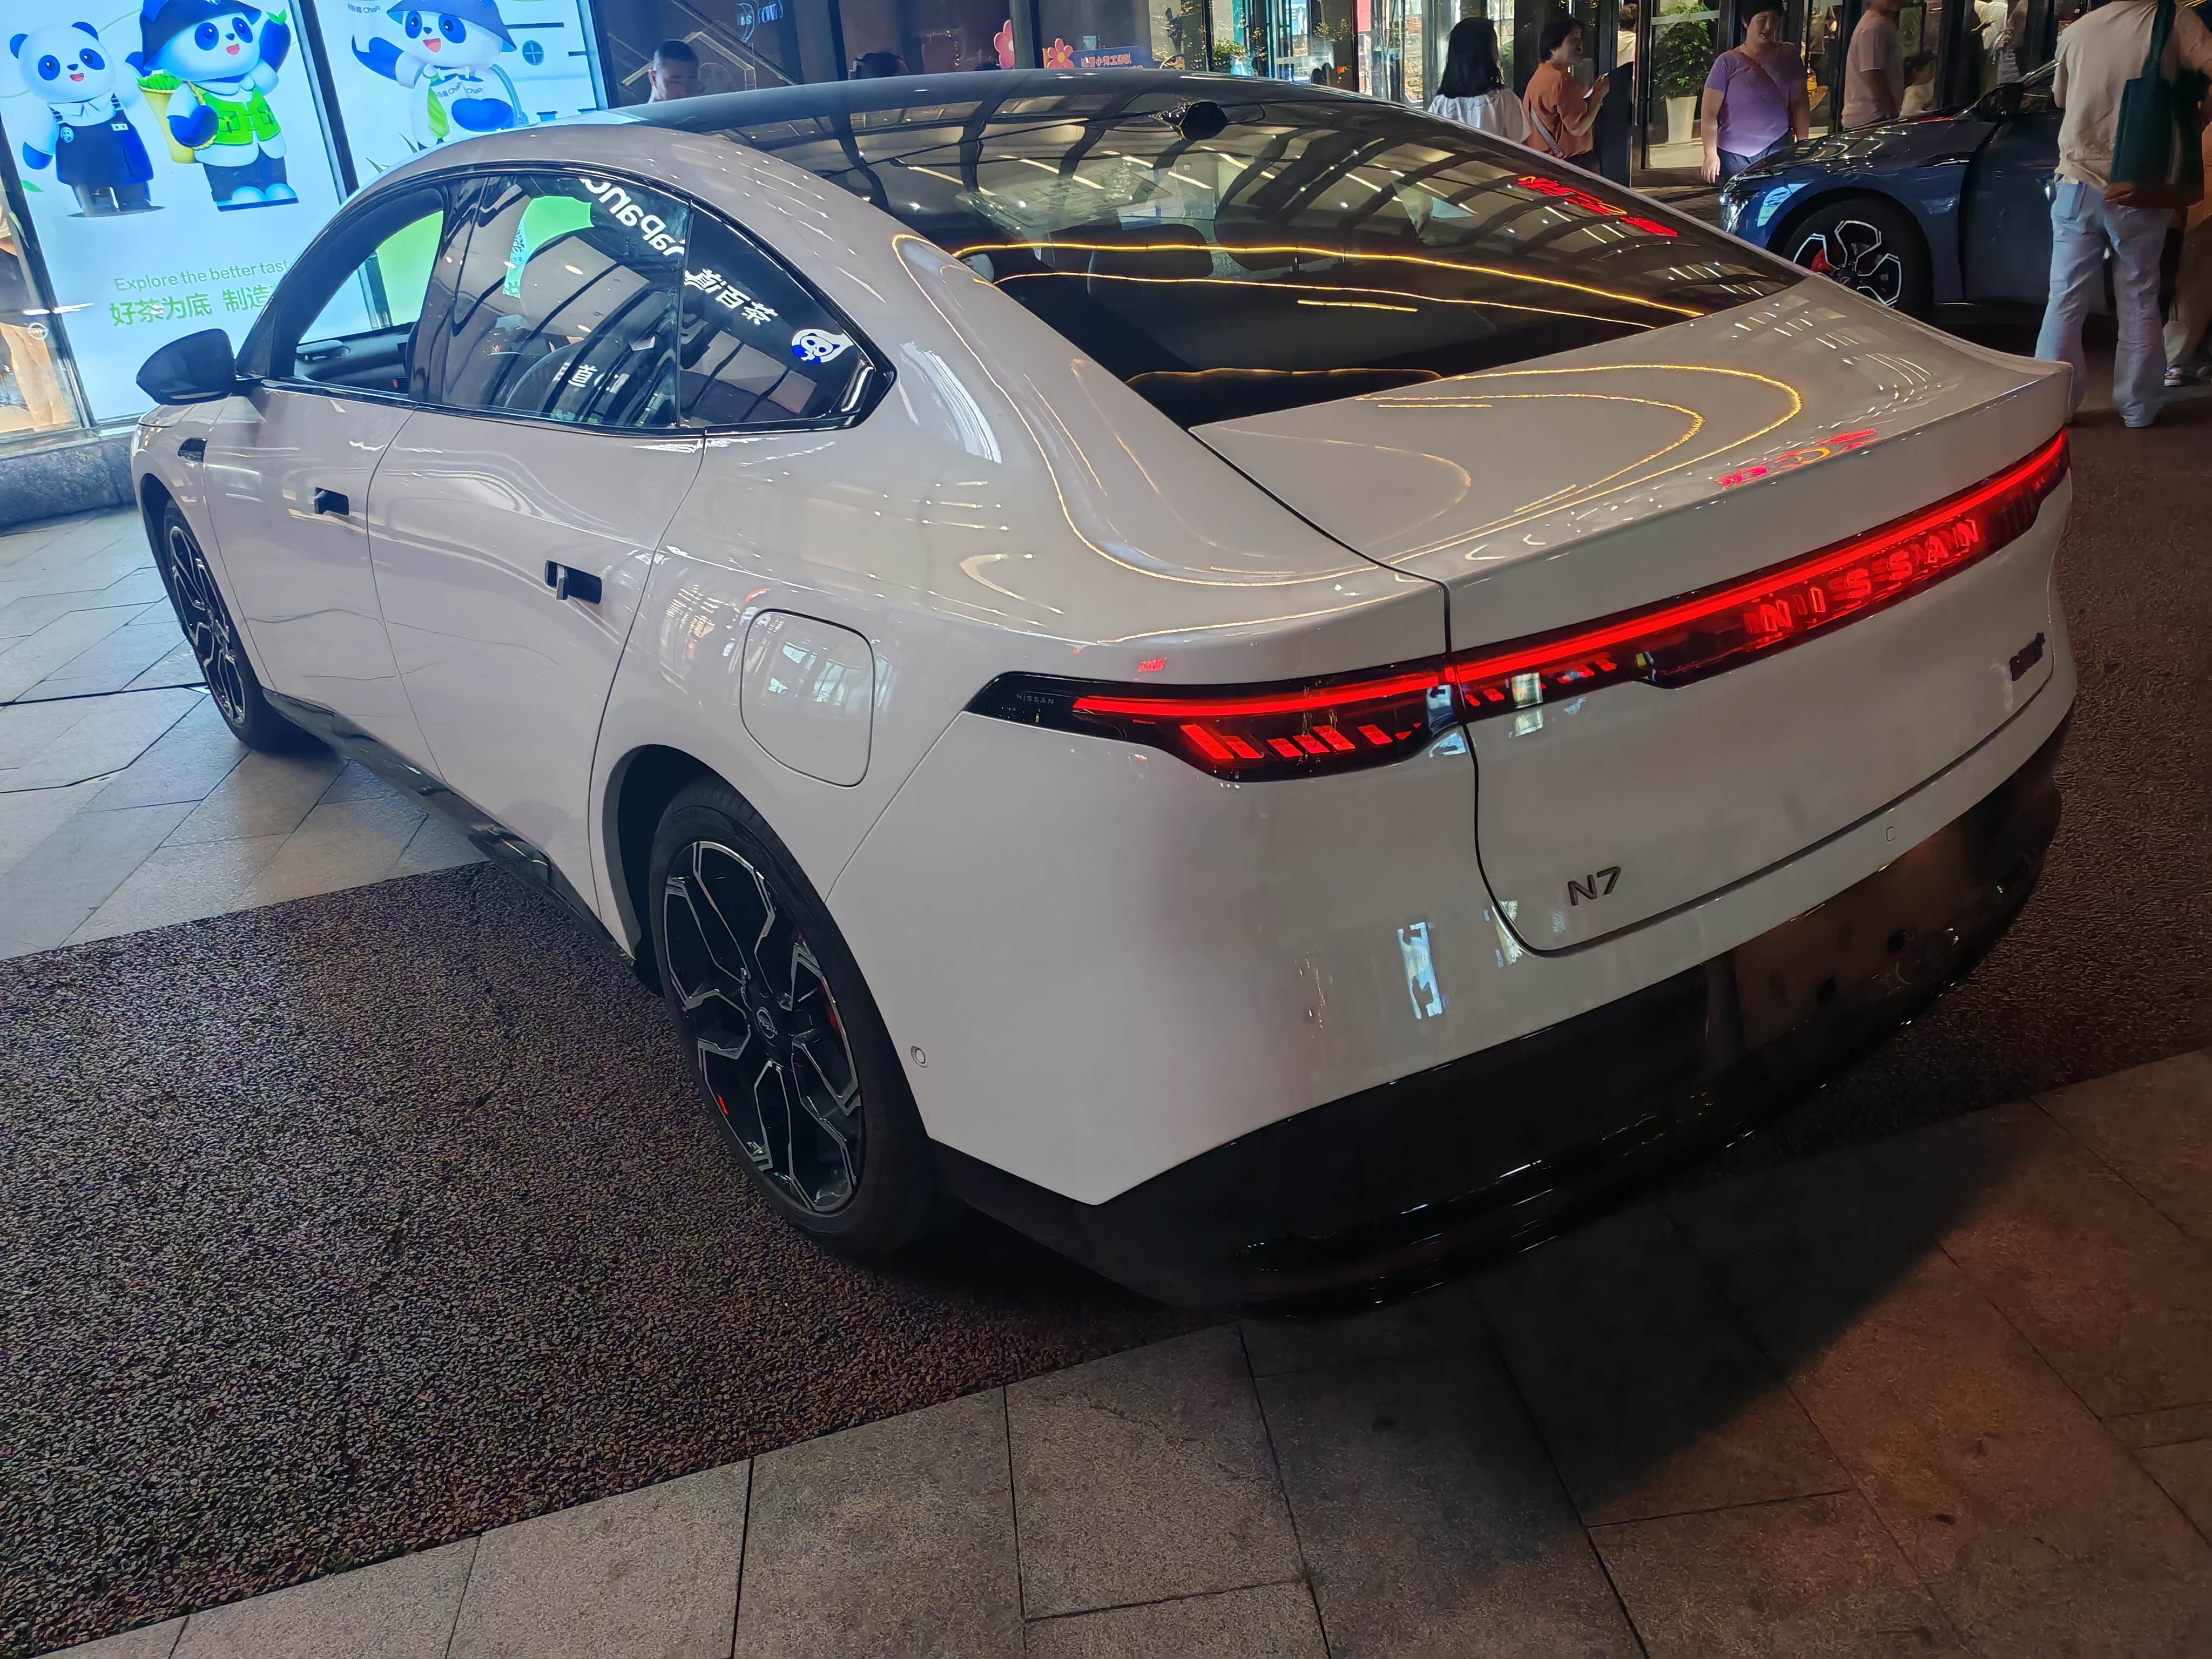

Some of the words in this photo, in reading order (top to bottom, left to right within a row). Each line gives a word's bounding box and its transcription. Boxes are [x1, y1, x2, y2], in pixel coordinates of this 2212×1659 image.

[114, 274, 178, 292] Explore
[180, 271, 207, 284] the
[209, 265, 257, 280] better
[259, 259, 288, 274] tast
[109, 293, 213, 327] 好茶为底
[222, 284, 276, 313] 制造
[1759, 518, 1979, 632] NISSAN
[1016, 693, 1054, 705] NISSAN
[1567, 866, 1622, 906] N7
